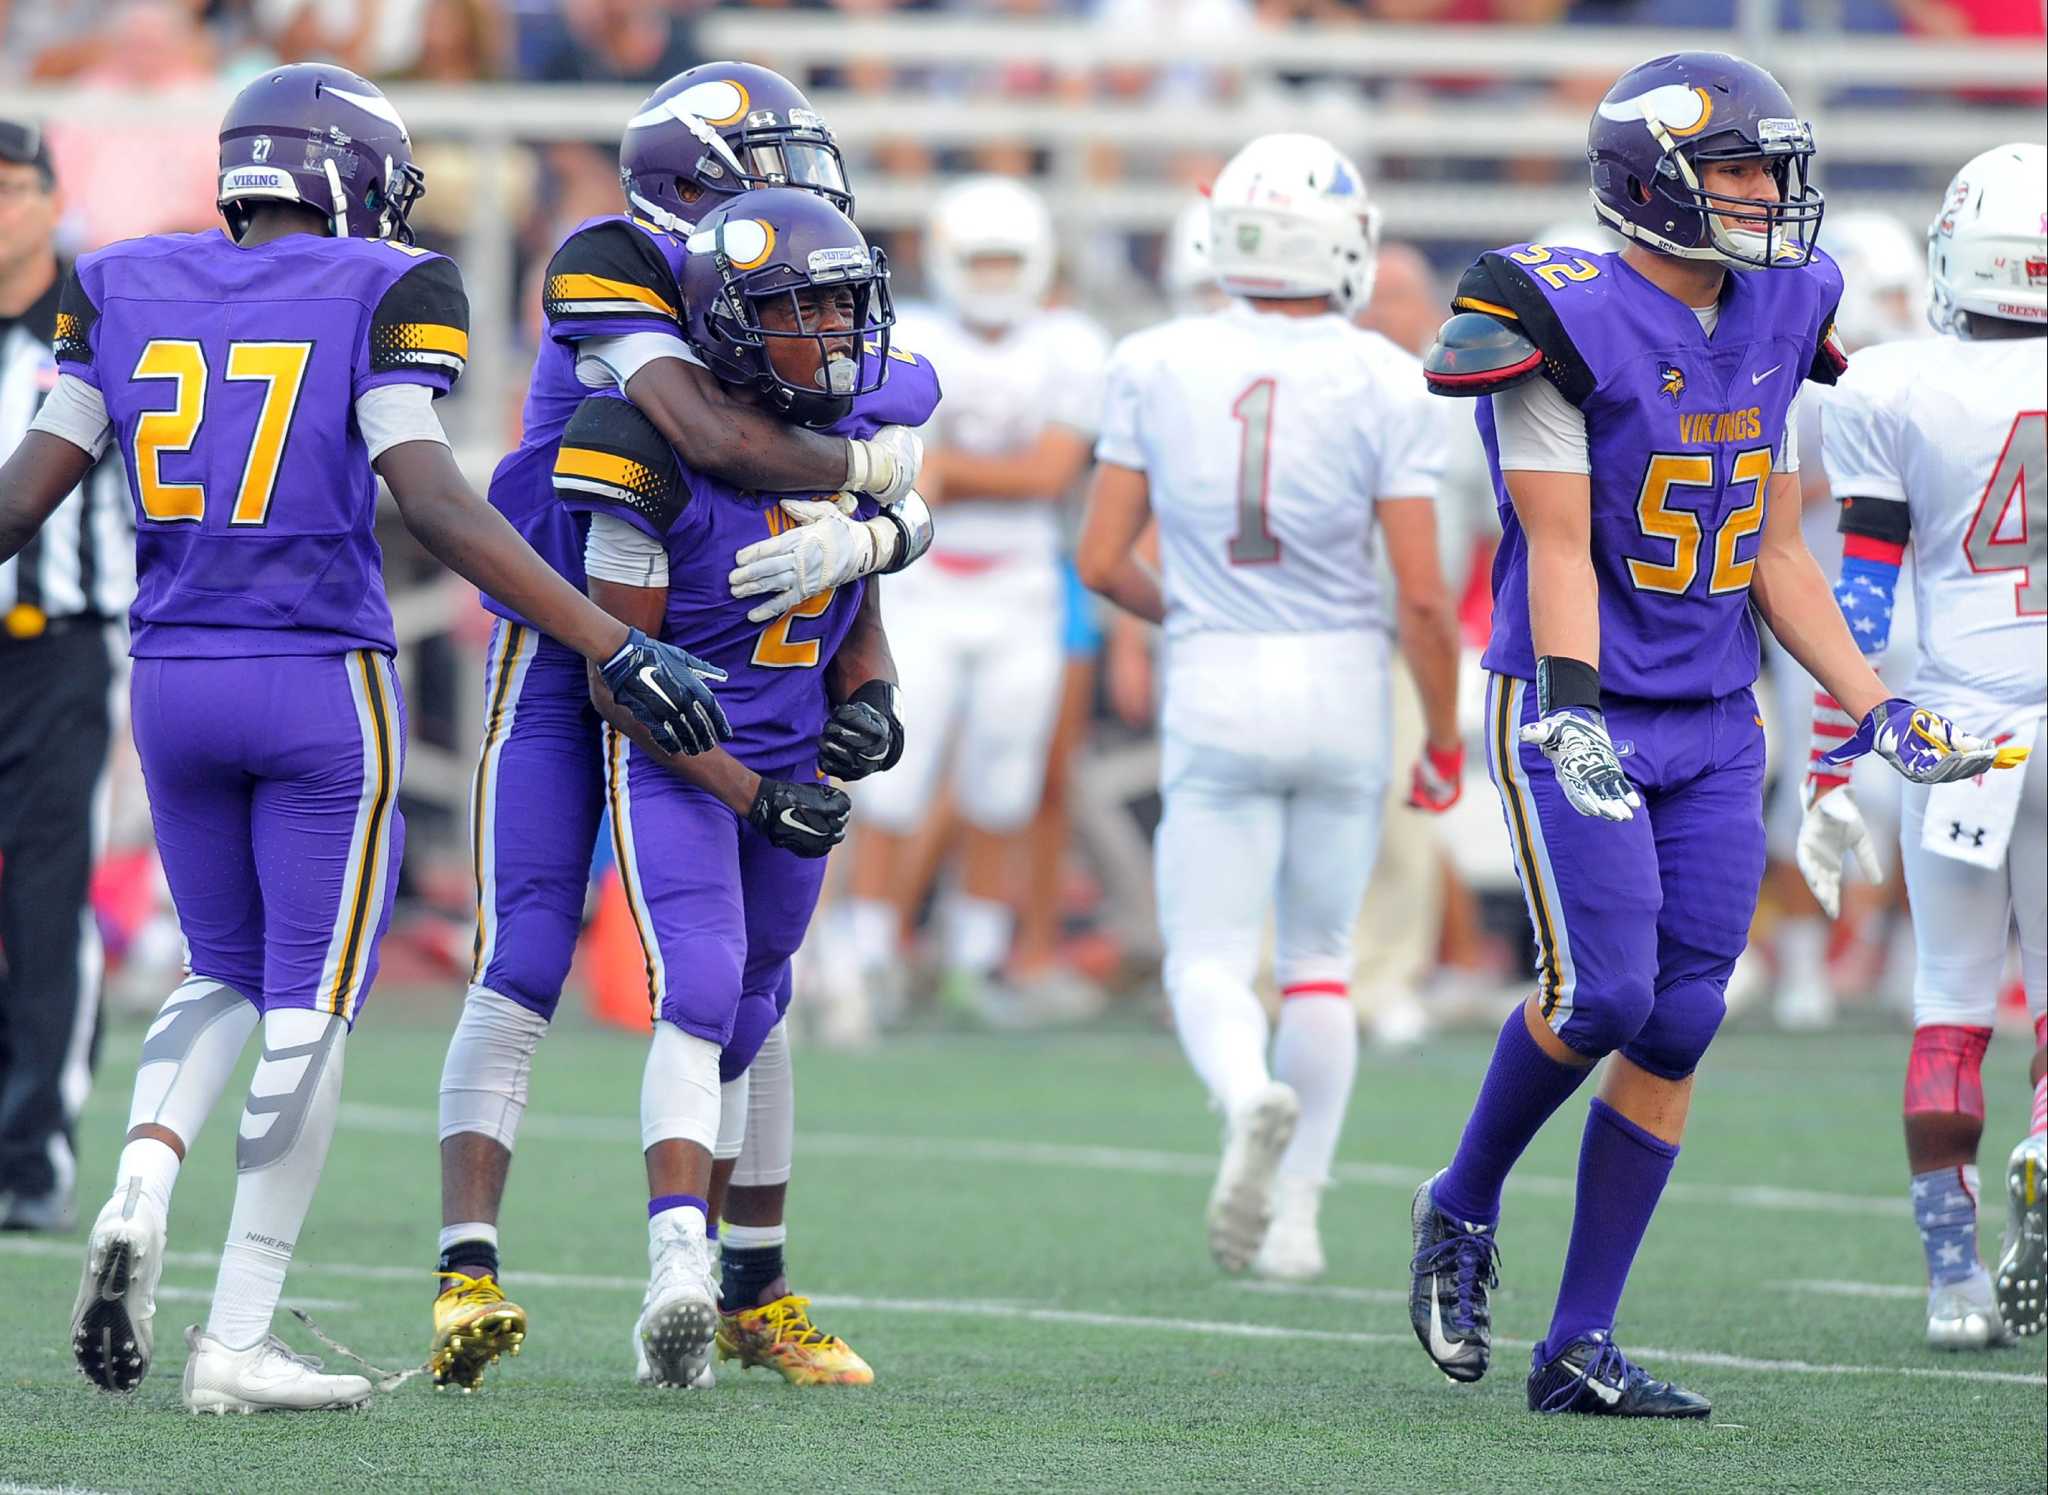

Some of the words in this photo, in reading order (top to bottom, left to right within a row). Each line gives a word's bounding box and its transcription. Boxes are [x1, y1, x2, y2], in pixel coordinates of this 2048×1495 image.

[233, 174, 280, 187] VIKING
[251, 138, 273, 161] 27
[1509, 244, 1602, 291] 52
[128, 336, 317, 529] 27
[1679, 407, 1761, 444] VIKINGS
[1227, 376, 1281, 567] 1
[1621, 444, 1775, 599] 52
[1961, 410, 2047, 617] 4
[749, 585, 838, 671] 2
[246, 1231, 275, 1247] NIKE
